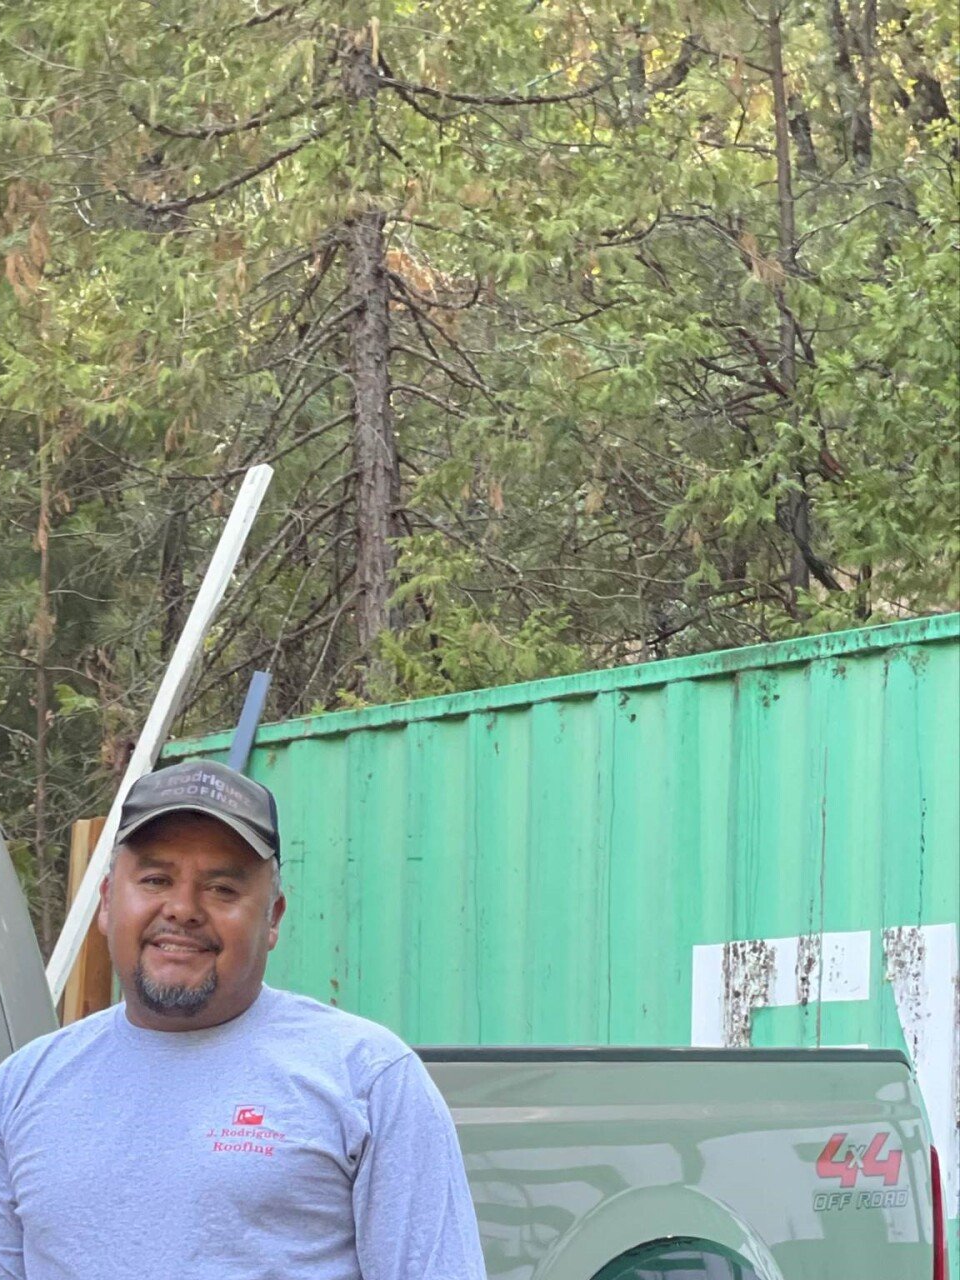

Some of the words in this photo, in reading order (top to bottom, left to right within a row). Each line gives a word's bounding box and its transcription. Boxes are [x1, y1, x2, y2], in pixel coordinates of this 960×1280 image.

[221, 1128, 286, 1140] Rodriguez
[213, 1141, 274, 1156] Roofing
[813, 1191, 853, 1212] OFF
[856, 1189, 909, 1210] ROAD
